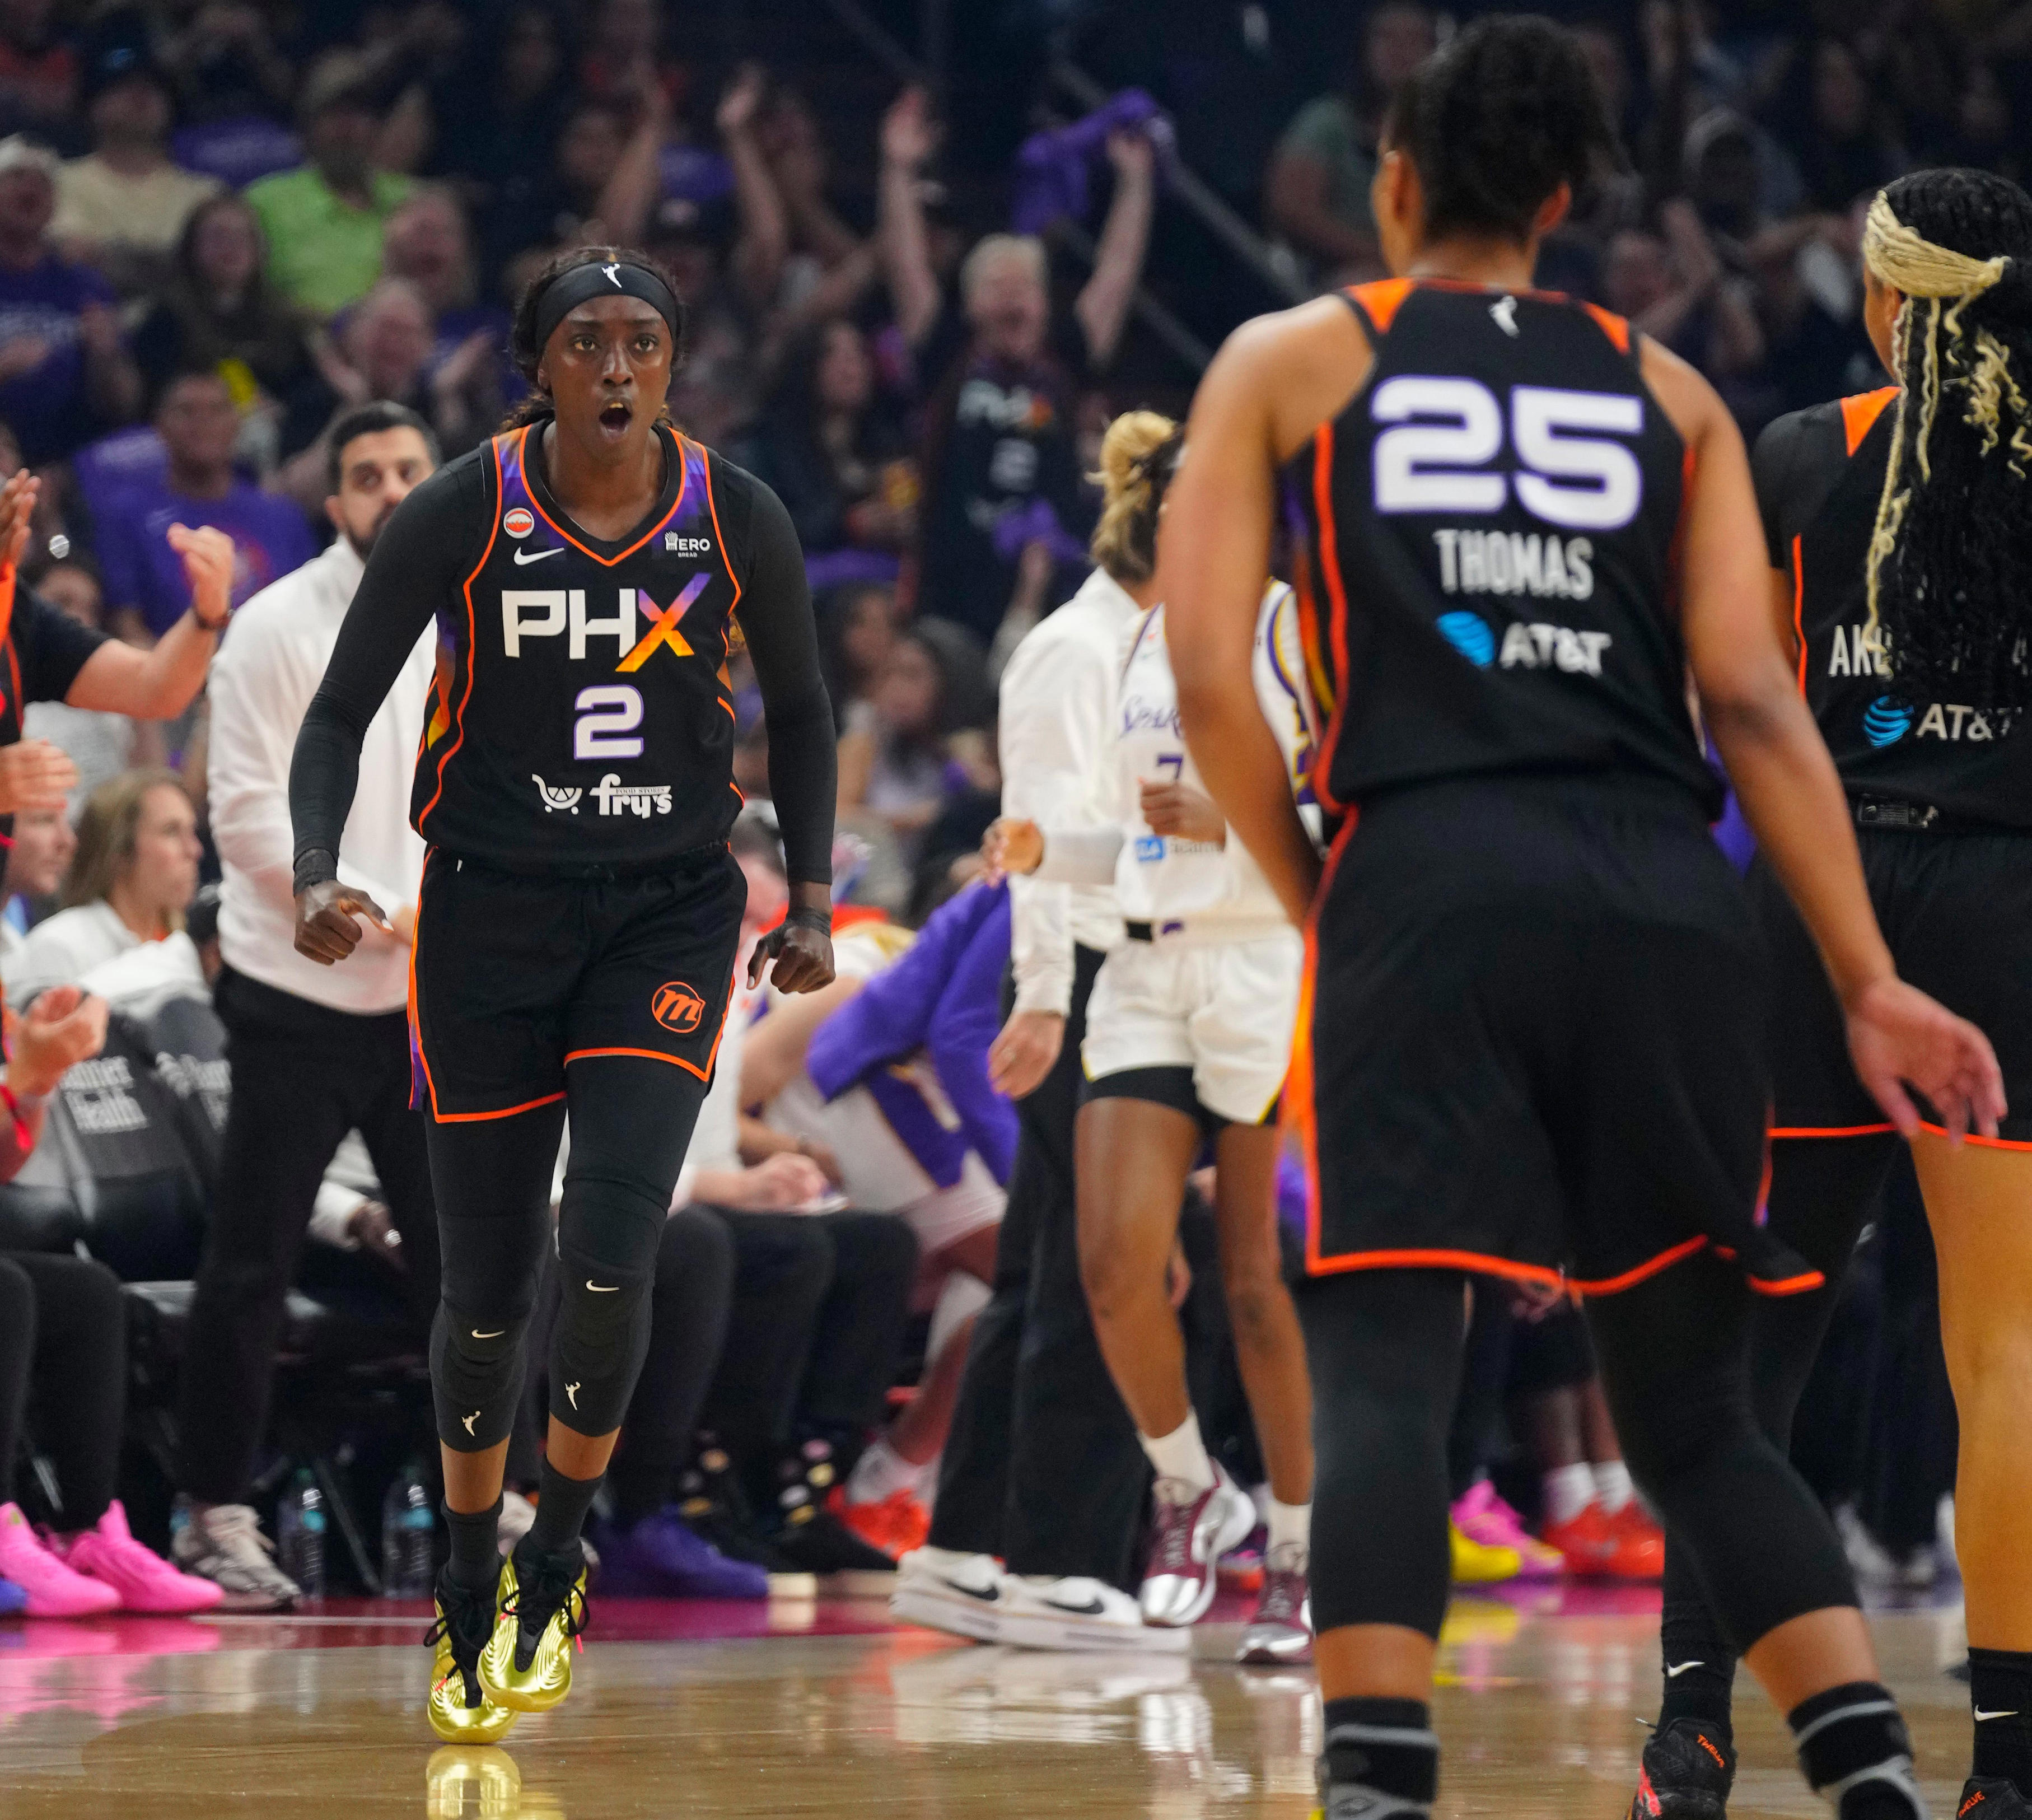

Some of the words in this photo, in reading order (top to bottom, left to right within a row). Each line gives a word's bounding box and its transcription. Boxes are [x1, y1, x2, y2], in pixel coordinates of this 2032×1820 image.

[1370, 374, 1644, 531] 25
[664, 530, 711, 552] HERO
[1432, 528, 1595, 601] THOMAS
[502, 572, 712, 673] PHX
[1498, 622, 1613, 677] AT&T
[573, 684, 644, 760] 2
[589, 773, 672, 819] fry's
[1156, 753, 1184, 780] 7
